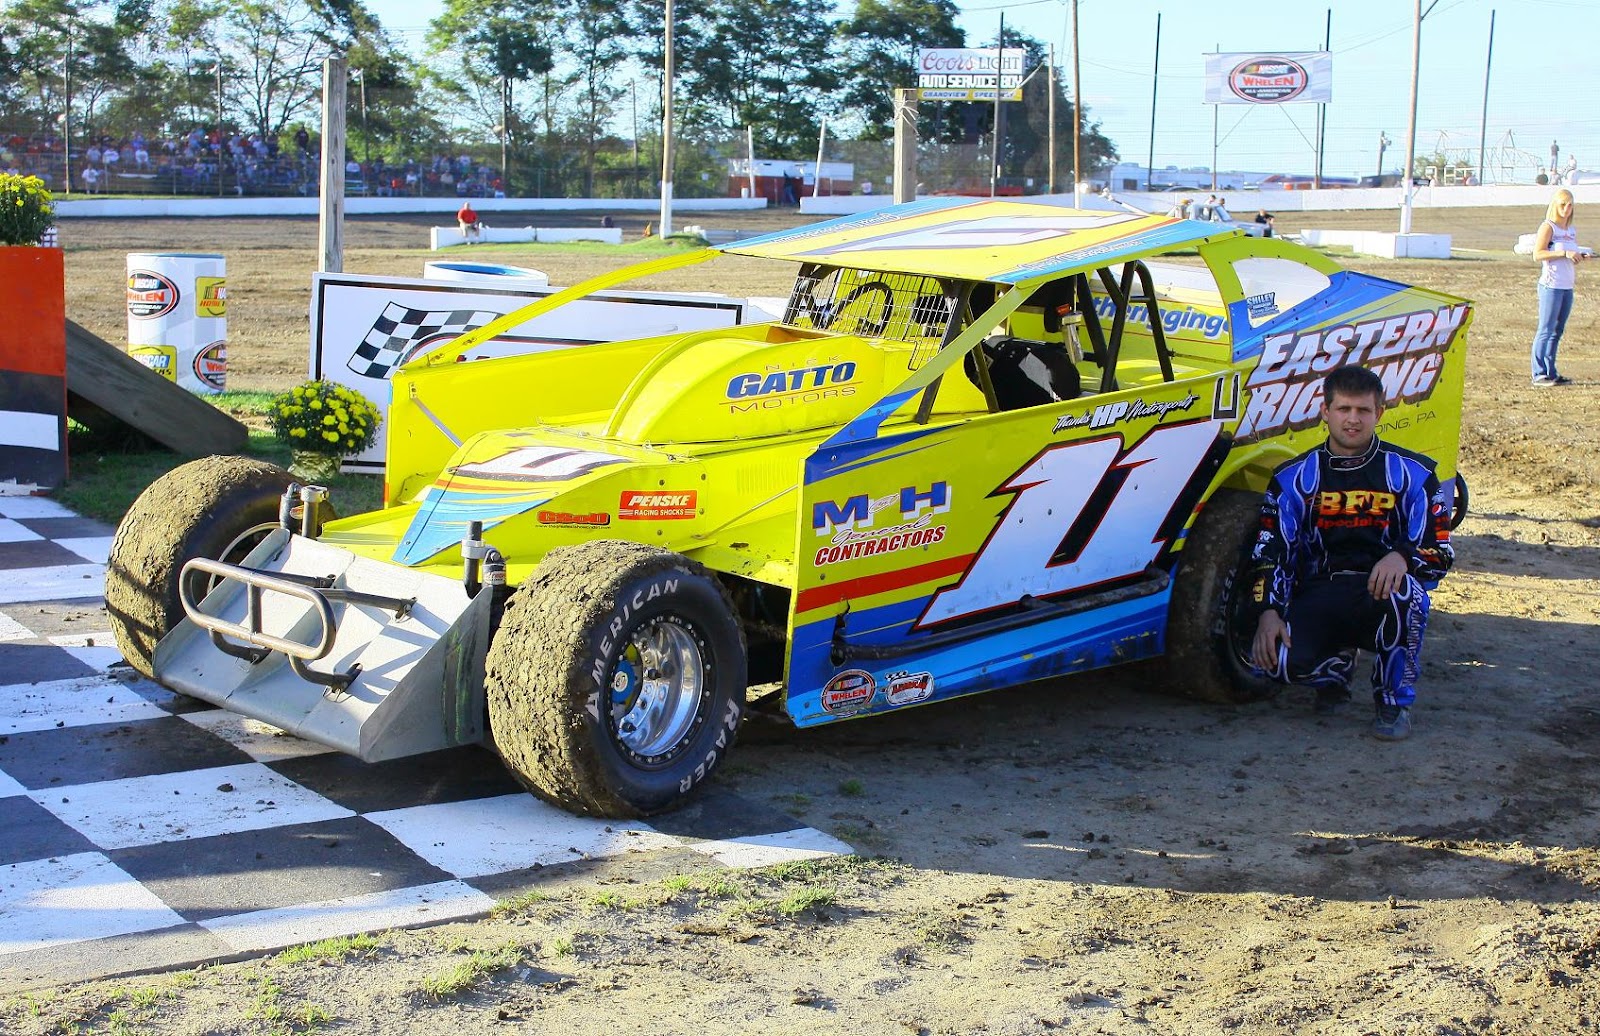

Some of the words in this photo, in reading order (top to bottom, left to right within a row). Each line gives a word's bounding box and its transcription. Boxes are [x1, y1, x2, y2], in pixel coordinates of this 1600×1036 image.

[921, 51, 974, 71] Coors
[979, 56, 1020, 70] LIGHT
[922, 90, 967, 98] GRANDVIEW
[1242, 76, 1295, 87] WHELEN
[1245, 304, 1471, 388] EASTERN
[765, 355, 841, 371] NICK
[726, 362, 857, 400] GATTO
[730, 387, 857, 414] MOTORS
[1052, 409, 1092, 434] Thanks
[1089, 401, 1129, 430] HP
[1416, 410, 1436, 424] PA
[628, 494, 692, 507] PENSKE
[633, 509, 660, 517] RACING
[660, 508, 685, 517] SHOCKS
[812, 493, 874, 537] M
[899, 480, 952, 521] H
[1319, 490, 1397, 516] BFP
[914, 418, 1226, 631] 11
[814, 525, 947, 568] CONTRACTORS
[585, 578, 680, 723] AMERICAN
[831, 686, 868, 702] WHELEN
[679, 697, 741, 794] RACER
